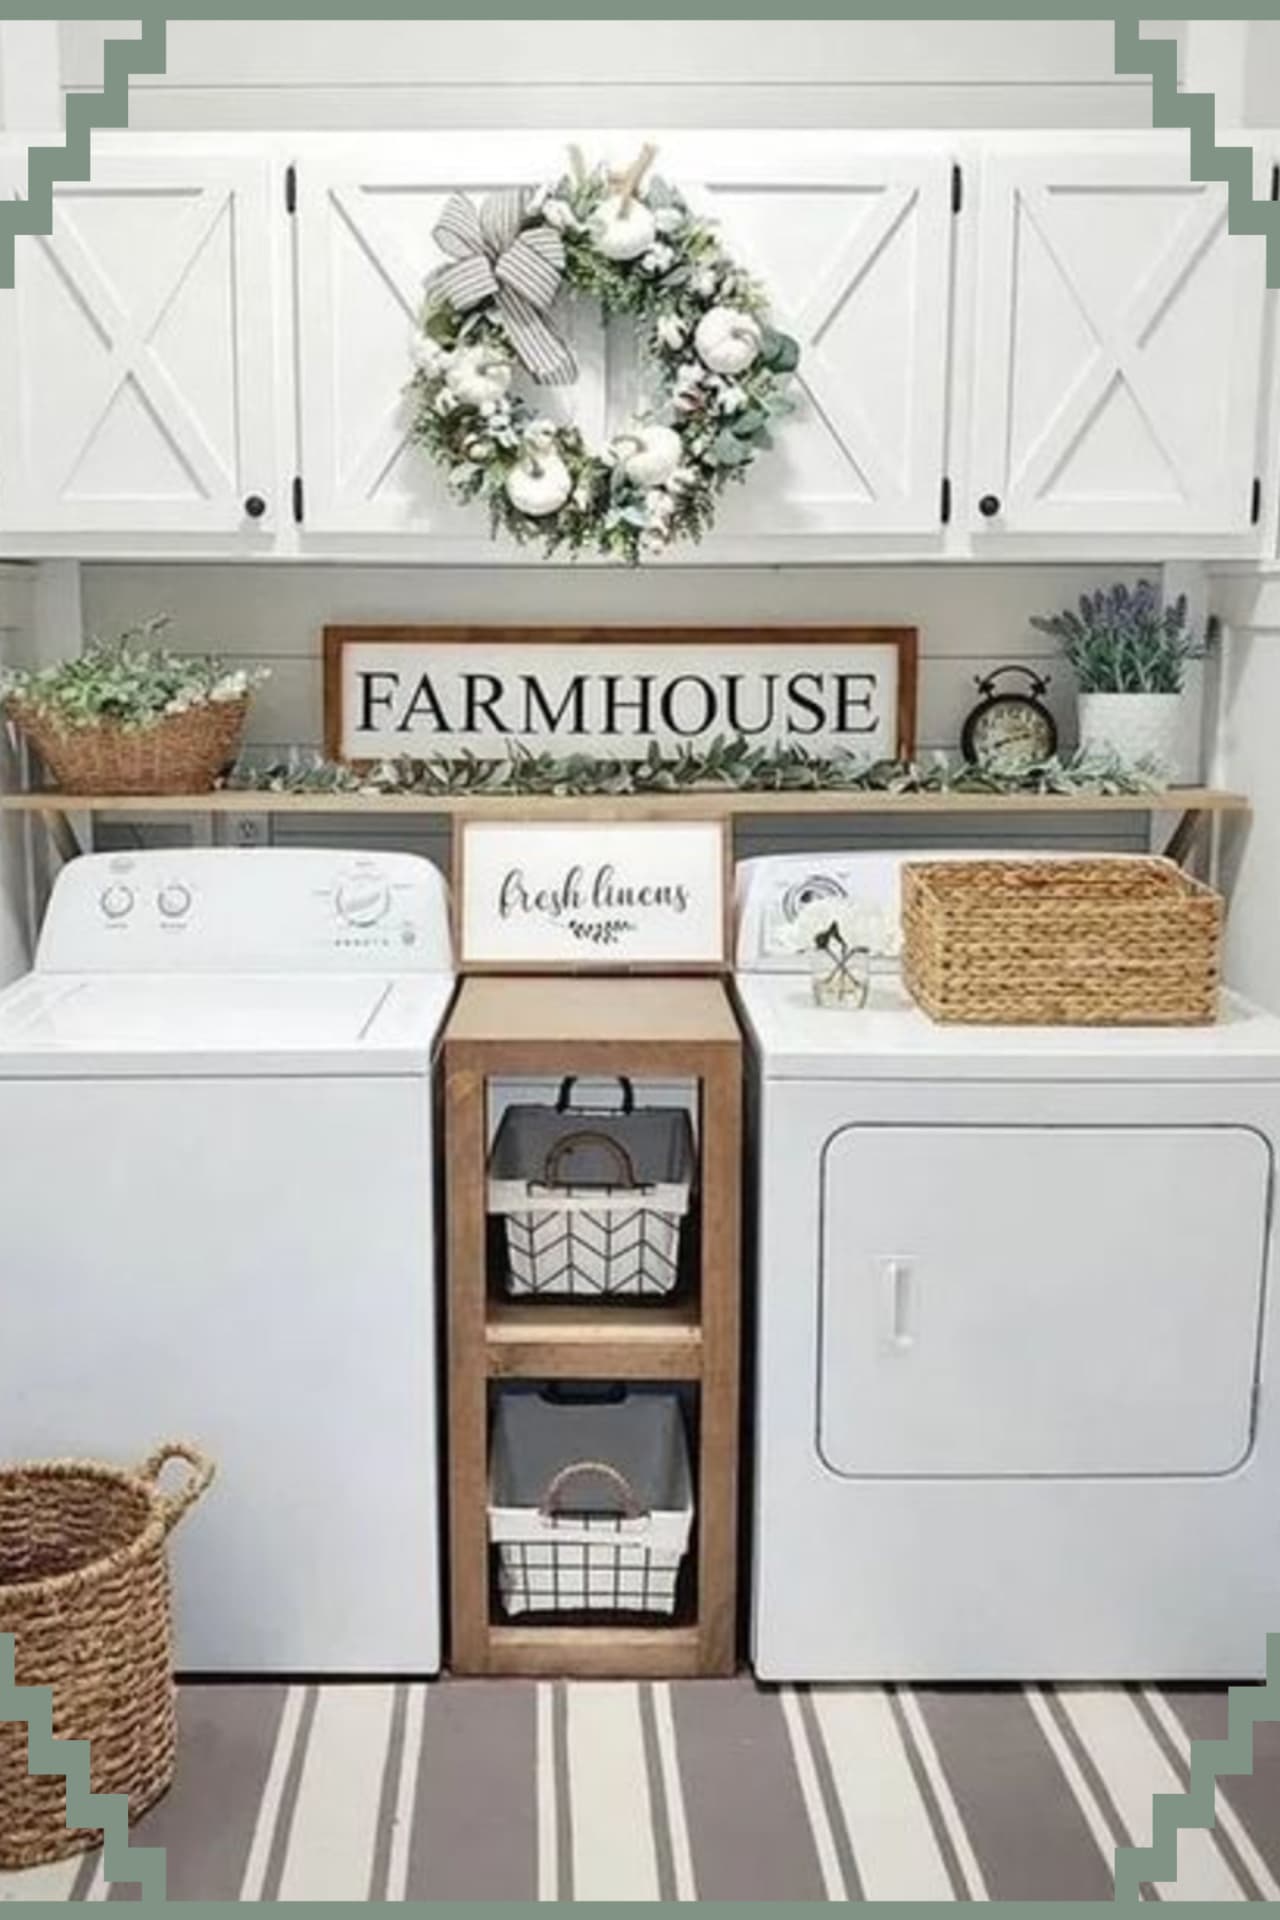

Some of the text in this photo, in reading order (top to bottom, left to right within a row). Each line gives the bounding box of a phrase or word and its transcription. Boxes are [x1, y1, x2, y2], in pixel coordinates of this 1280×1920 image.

[355, 671, 880, 736] FARMHOUSE
[498, 863, 689, 919] fresh linens
